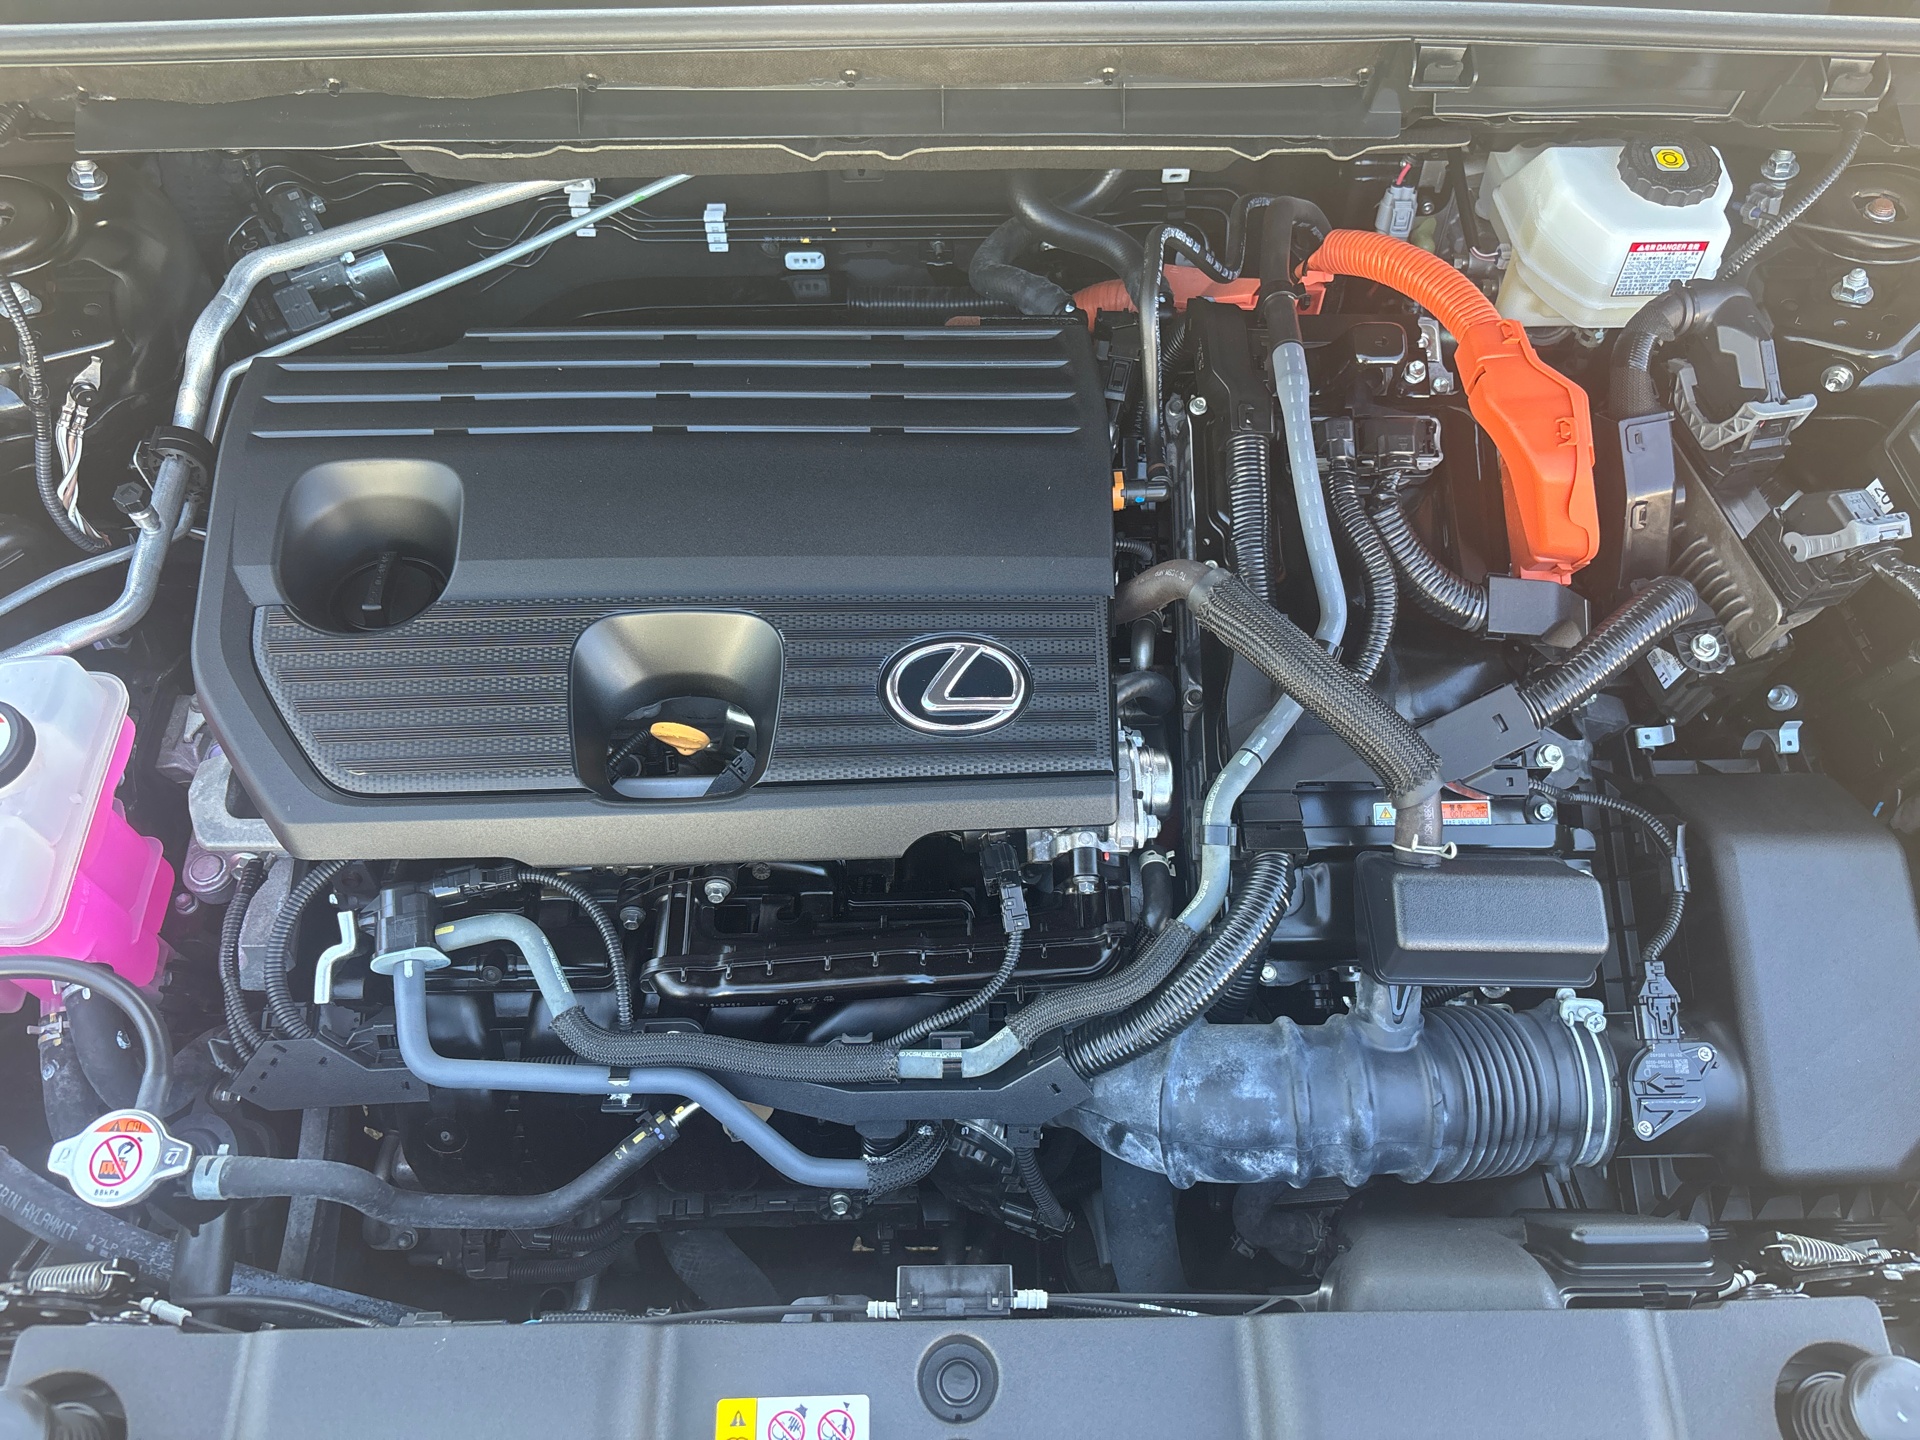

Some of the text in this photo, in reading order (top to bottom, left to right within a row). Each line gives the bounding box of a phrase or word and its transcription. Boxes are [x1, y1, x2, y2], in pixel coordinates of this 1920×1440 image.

[1656, 243, 1688, 251] DANGER
[93, 1188, 119, 1197] 88kPa
[0, 1183, 78, 1241] RIN HYLAMMIT
